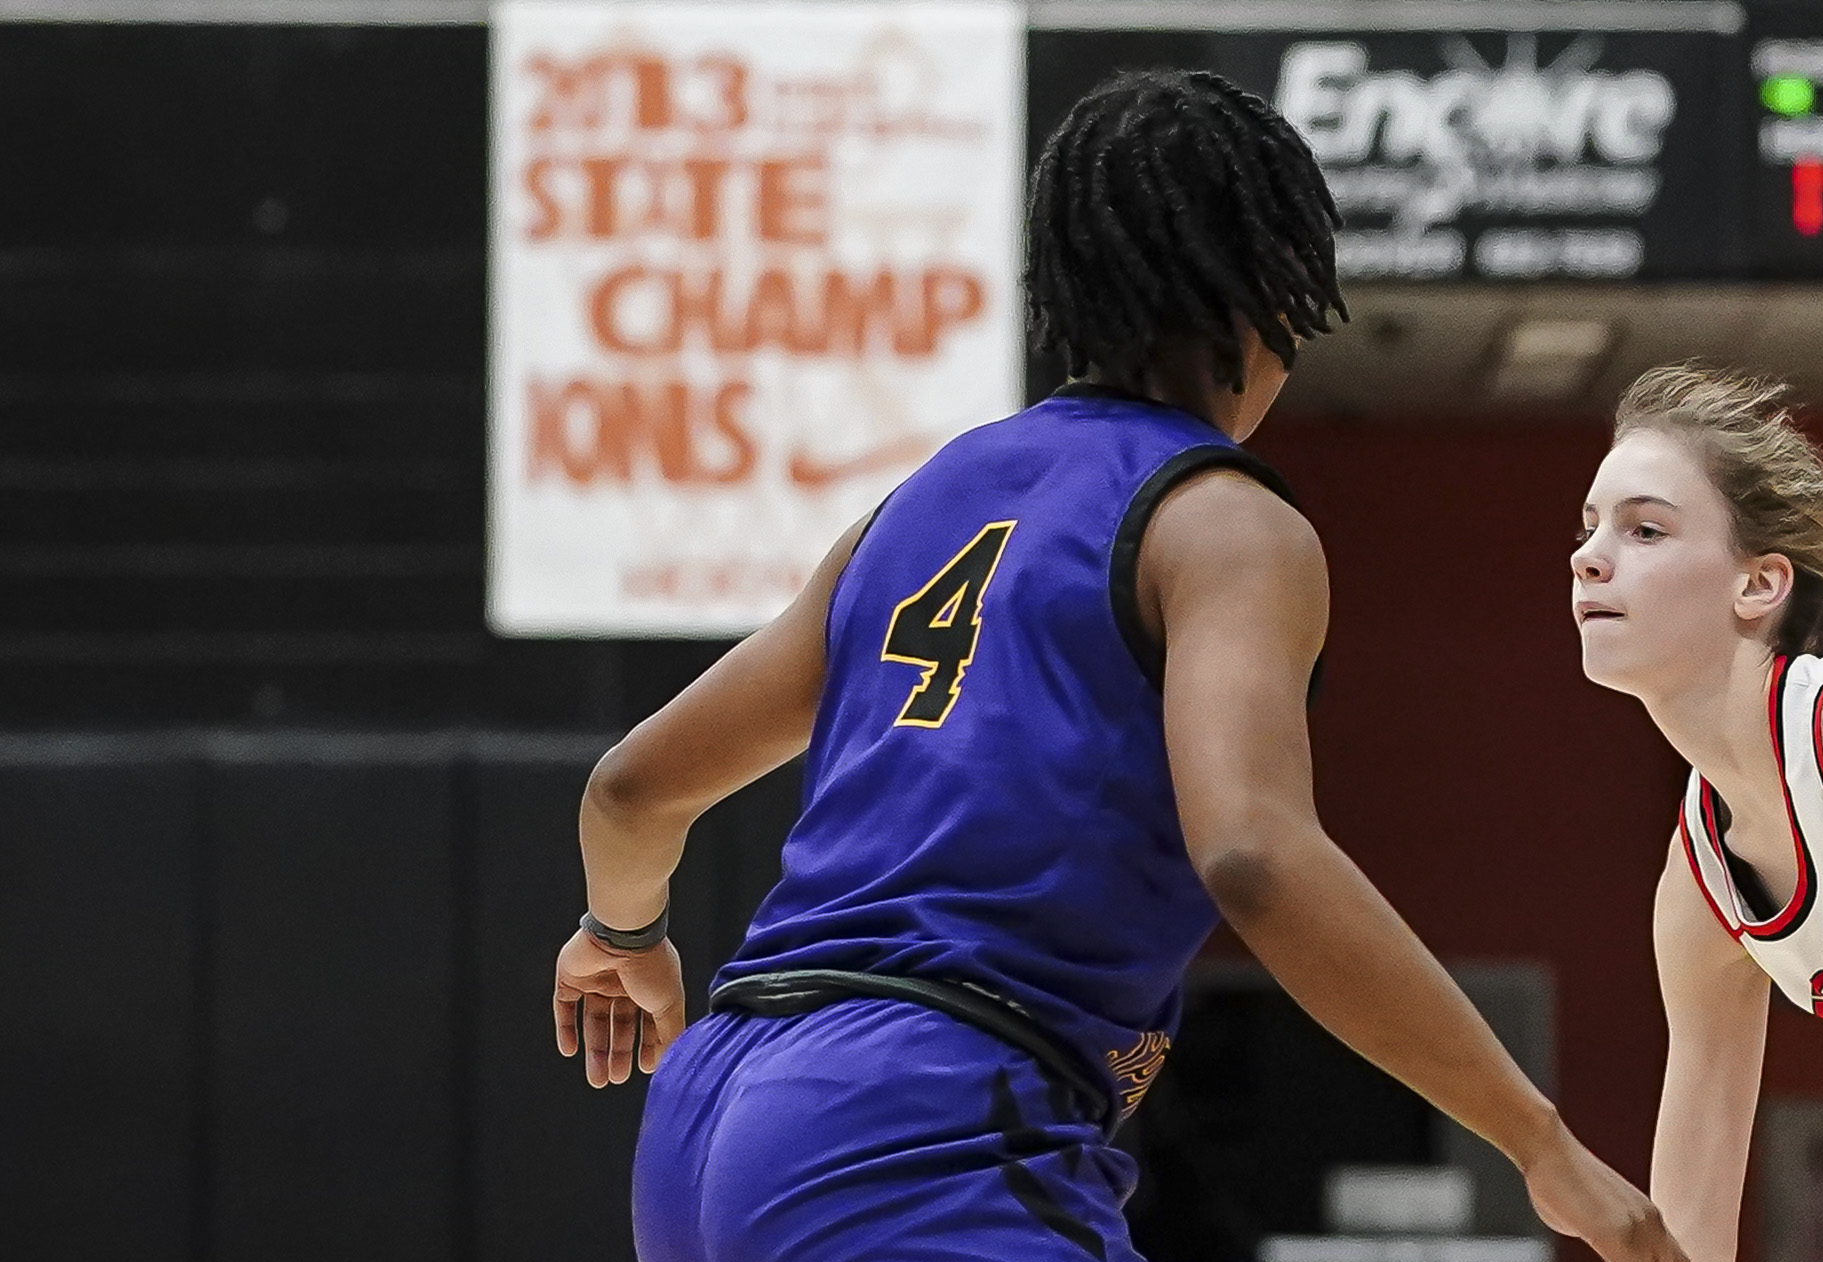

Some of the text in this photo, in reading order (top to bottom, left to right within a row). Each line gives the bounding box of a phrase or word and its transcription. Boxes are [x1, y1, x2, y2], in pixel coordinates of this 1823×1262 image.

[523, 154, 830, 245] STATE
[586, 264, 987, 357] CHAMP
[524, 378, 757, 487] IONS
[879, 518, 1019, 729] 4
